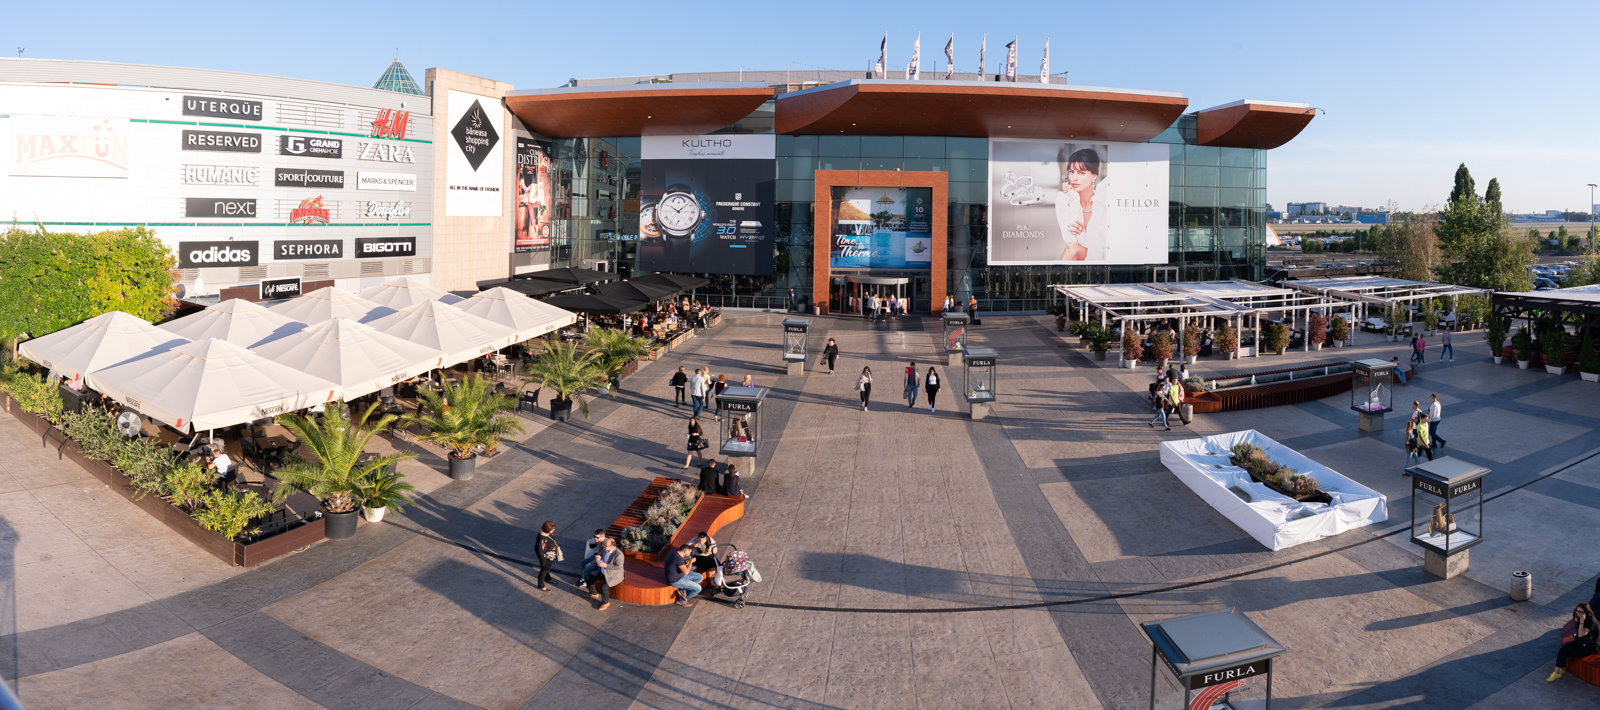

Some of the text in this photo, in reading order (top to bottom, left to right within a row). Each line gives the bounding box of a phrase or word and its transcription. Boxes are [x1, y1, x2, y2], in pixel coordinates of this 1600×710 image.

[188, 99, 260, 116] UTERQÜE
[372, 108, 410, 140] H&M
[188, 134, 258, 148] RESERVED
[310, 139, 340, 148] GRAND
[464, 136, 489, 146] shopping
[682, 139, 732, 148] KULTHO
[360, 142, 416, 164] ZARA
[465, 144, 476, 154] city
[185, 164, 257, 184] HUMANIC
[214, 200, 255, 215] next
[1116, 198, 1160, 208] TEILOR
[716, 226, 736, 234] 3.0
[835, 234, 856, 246] Time
[281, 244, 340, 256] SEPHORA
[363, 242, 412, 253] BIGOTTI
[190, 246, 251, 263] adidas
[1419, 481, 1442, 495] FURLA
[1454, 482, 1477, 495] FURLA
[1204, 665, 1256, 684] FURLA
